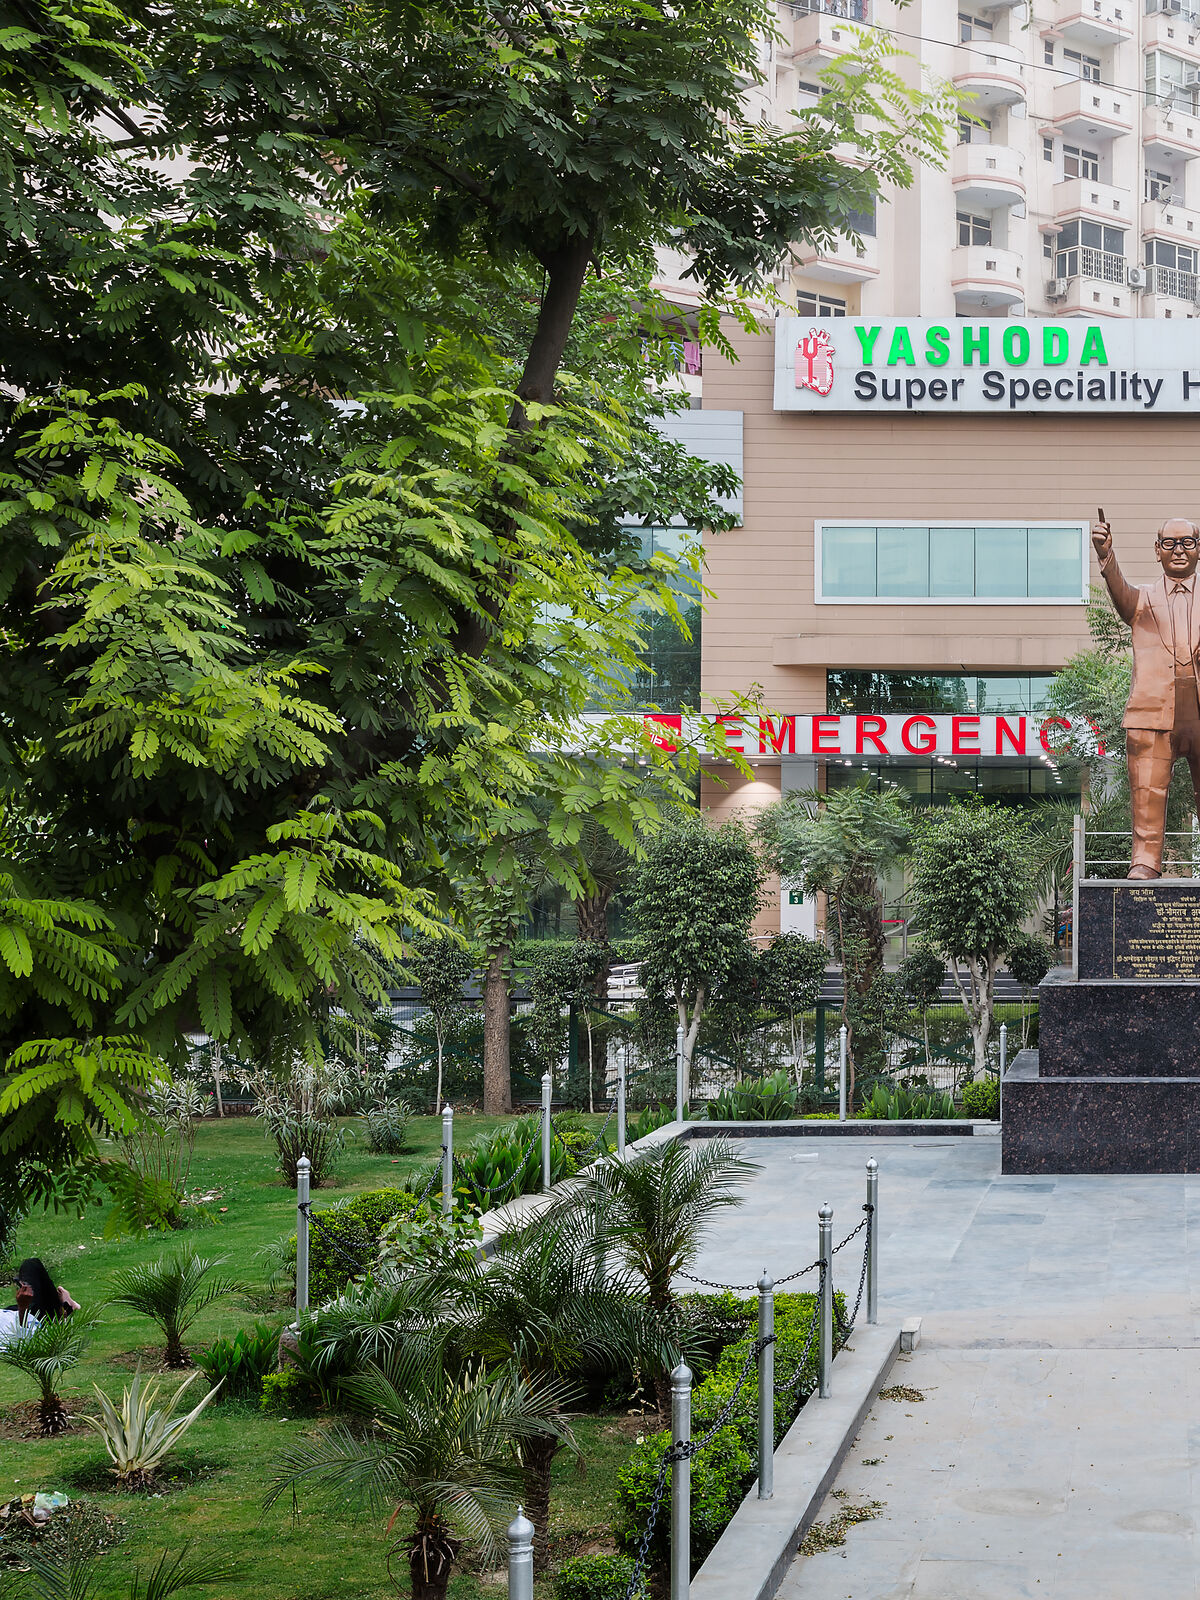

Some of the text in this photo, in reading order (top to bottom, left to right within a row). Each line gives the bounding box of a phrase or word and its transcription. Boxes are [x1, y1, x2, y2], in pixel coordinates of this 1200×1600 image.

[854, 325, 1110, 366] YASHODA
[854, 371, 966, 408] Super
[982, 370, 1163, 408] Speciality
[793, 896, 799, 904] 3
